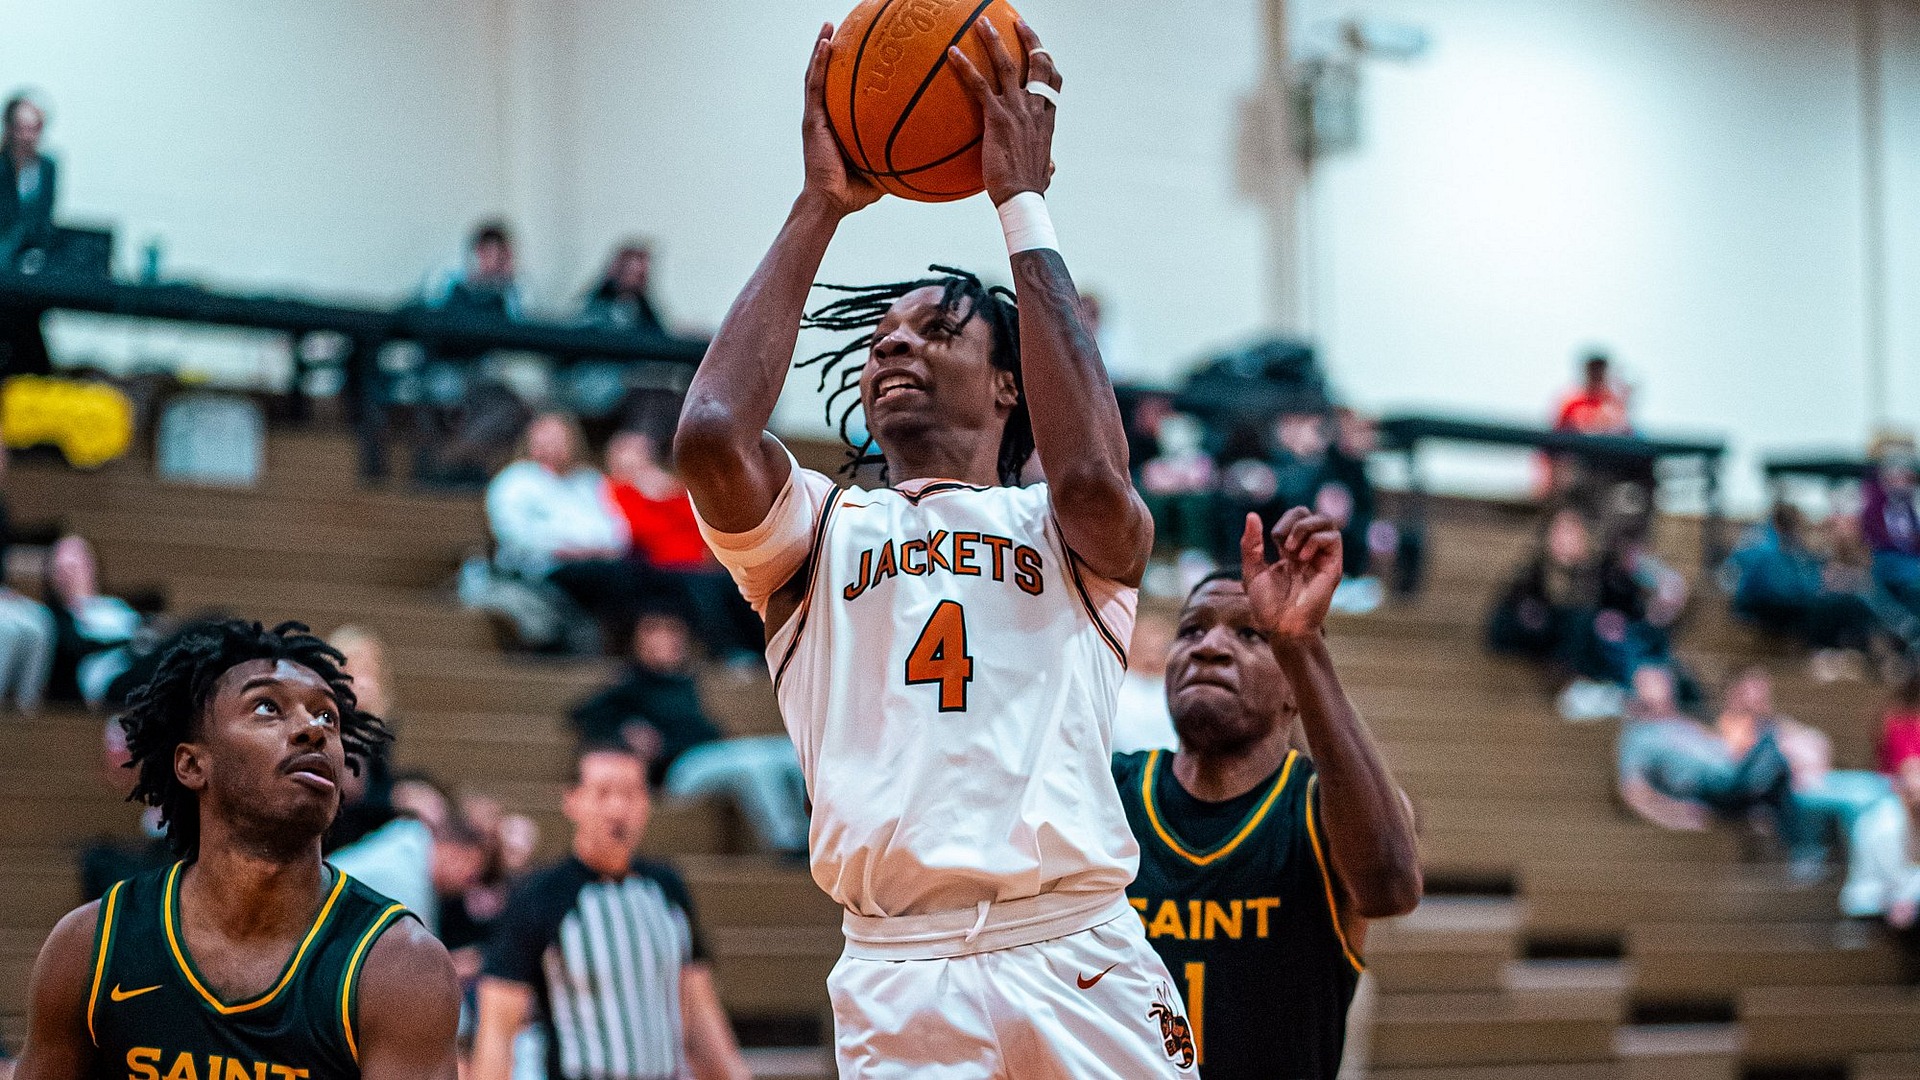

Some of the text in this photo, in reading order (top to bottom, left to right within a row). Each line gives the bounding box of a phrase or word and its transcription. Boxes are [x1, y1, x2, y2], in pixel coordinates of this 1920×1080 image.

[863, 0, 954, 94] ilson
[843, 529, 1043, 602] JACKETS
[905, 599, 973, 713] 4
[1184, 962, 1205, 1065] 1
